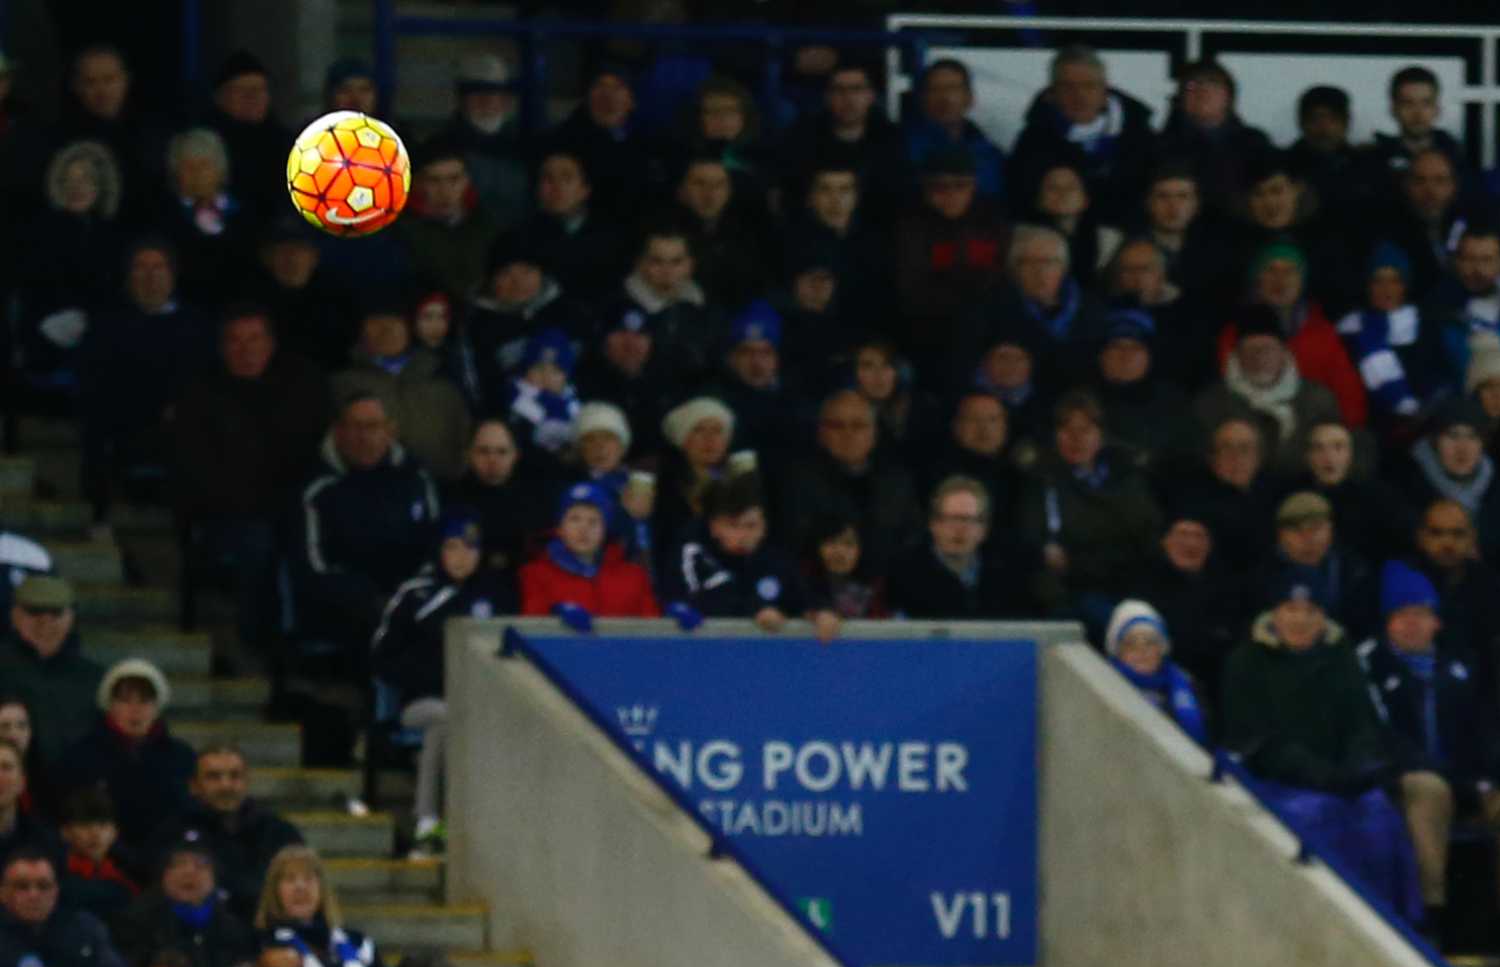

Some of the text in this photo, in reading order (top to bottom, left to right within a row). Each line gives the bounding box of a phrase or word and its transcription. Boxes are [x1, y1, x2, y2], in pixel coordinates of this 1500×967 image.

[637, 740, 969, 792] NG POWER
[701, 801, 863, 836] TADIUM
[931, 893, 1011, 940] V11
